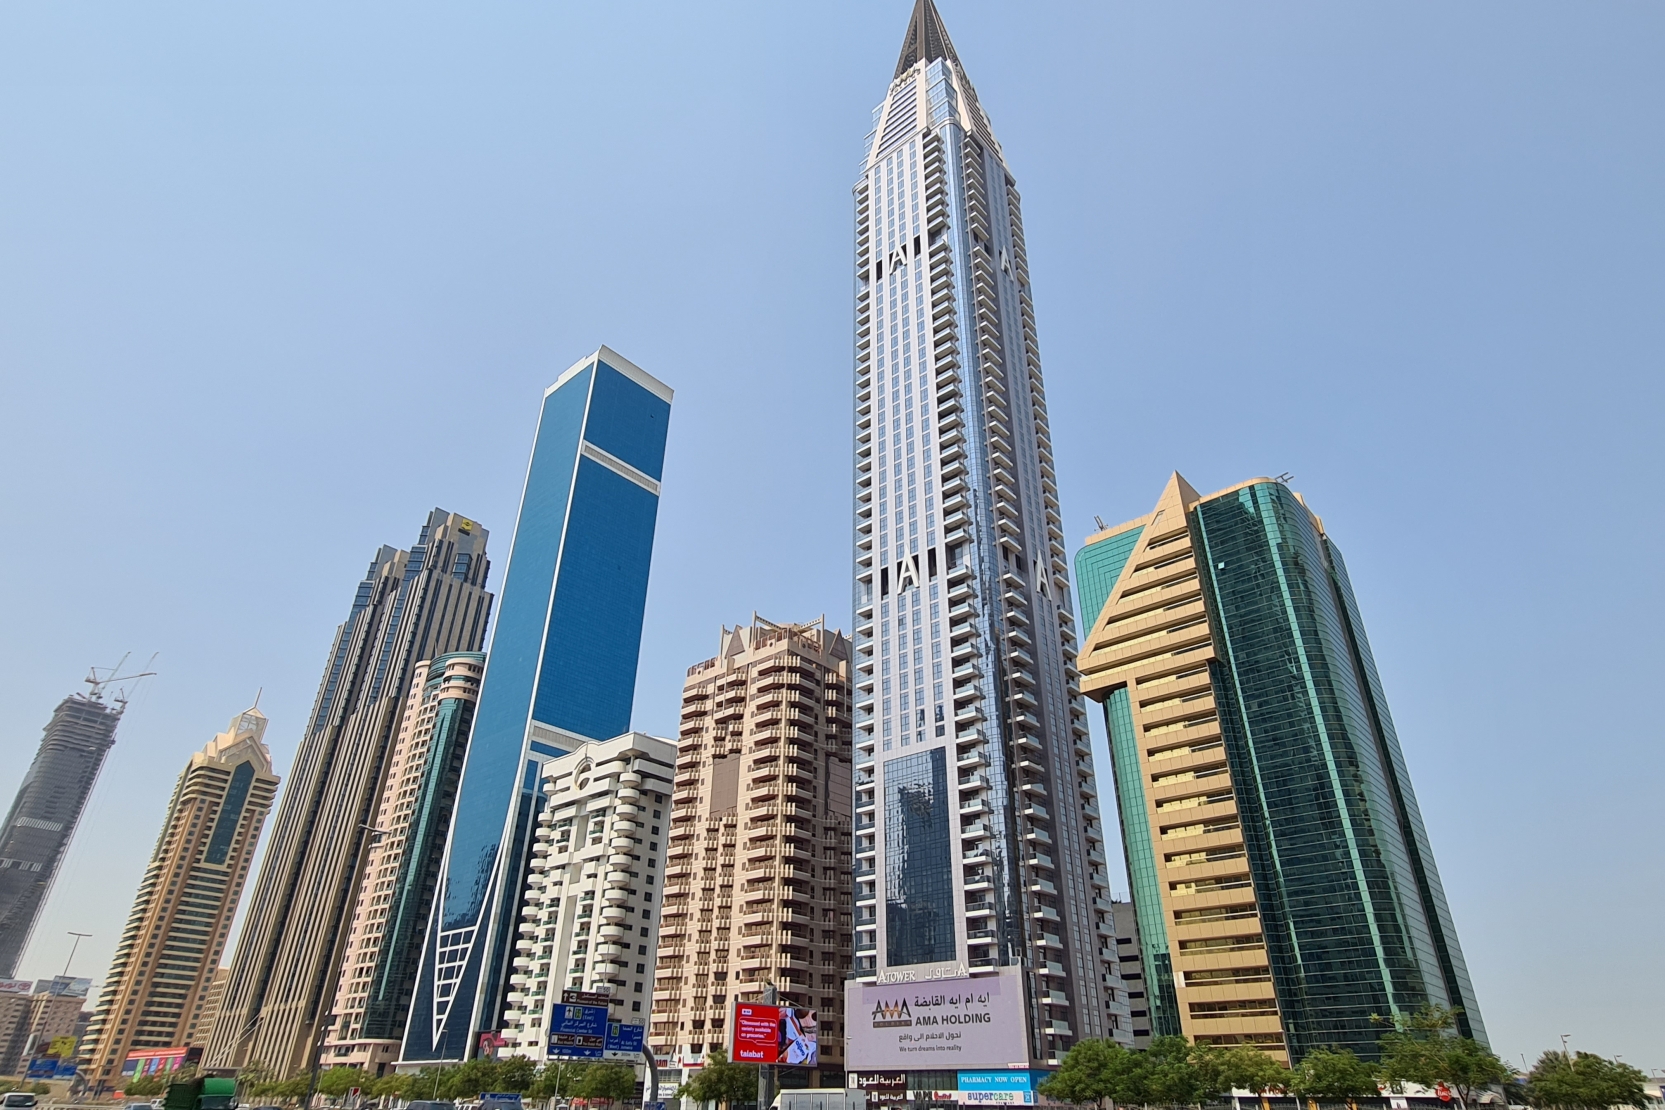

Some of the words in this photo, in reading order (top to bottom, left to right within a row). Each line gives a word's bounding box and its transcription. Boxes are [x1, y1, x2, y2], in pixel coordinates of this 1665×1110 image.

[914, 994, 946, 1010] القابضة
[915, 1015, 939, 1026] AMA
[942, 1012, 991, 1025] HOLDING
[740, 1049, 764, 1058] talabat
[946, 1044, 962, 1052] reality
[858, 1074, 879, 1087] للعود
[879, 1073, 906, 1087] العربية
[967, 1091, 1014, 1103] supercare
